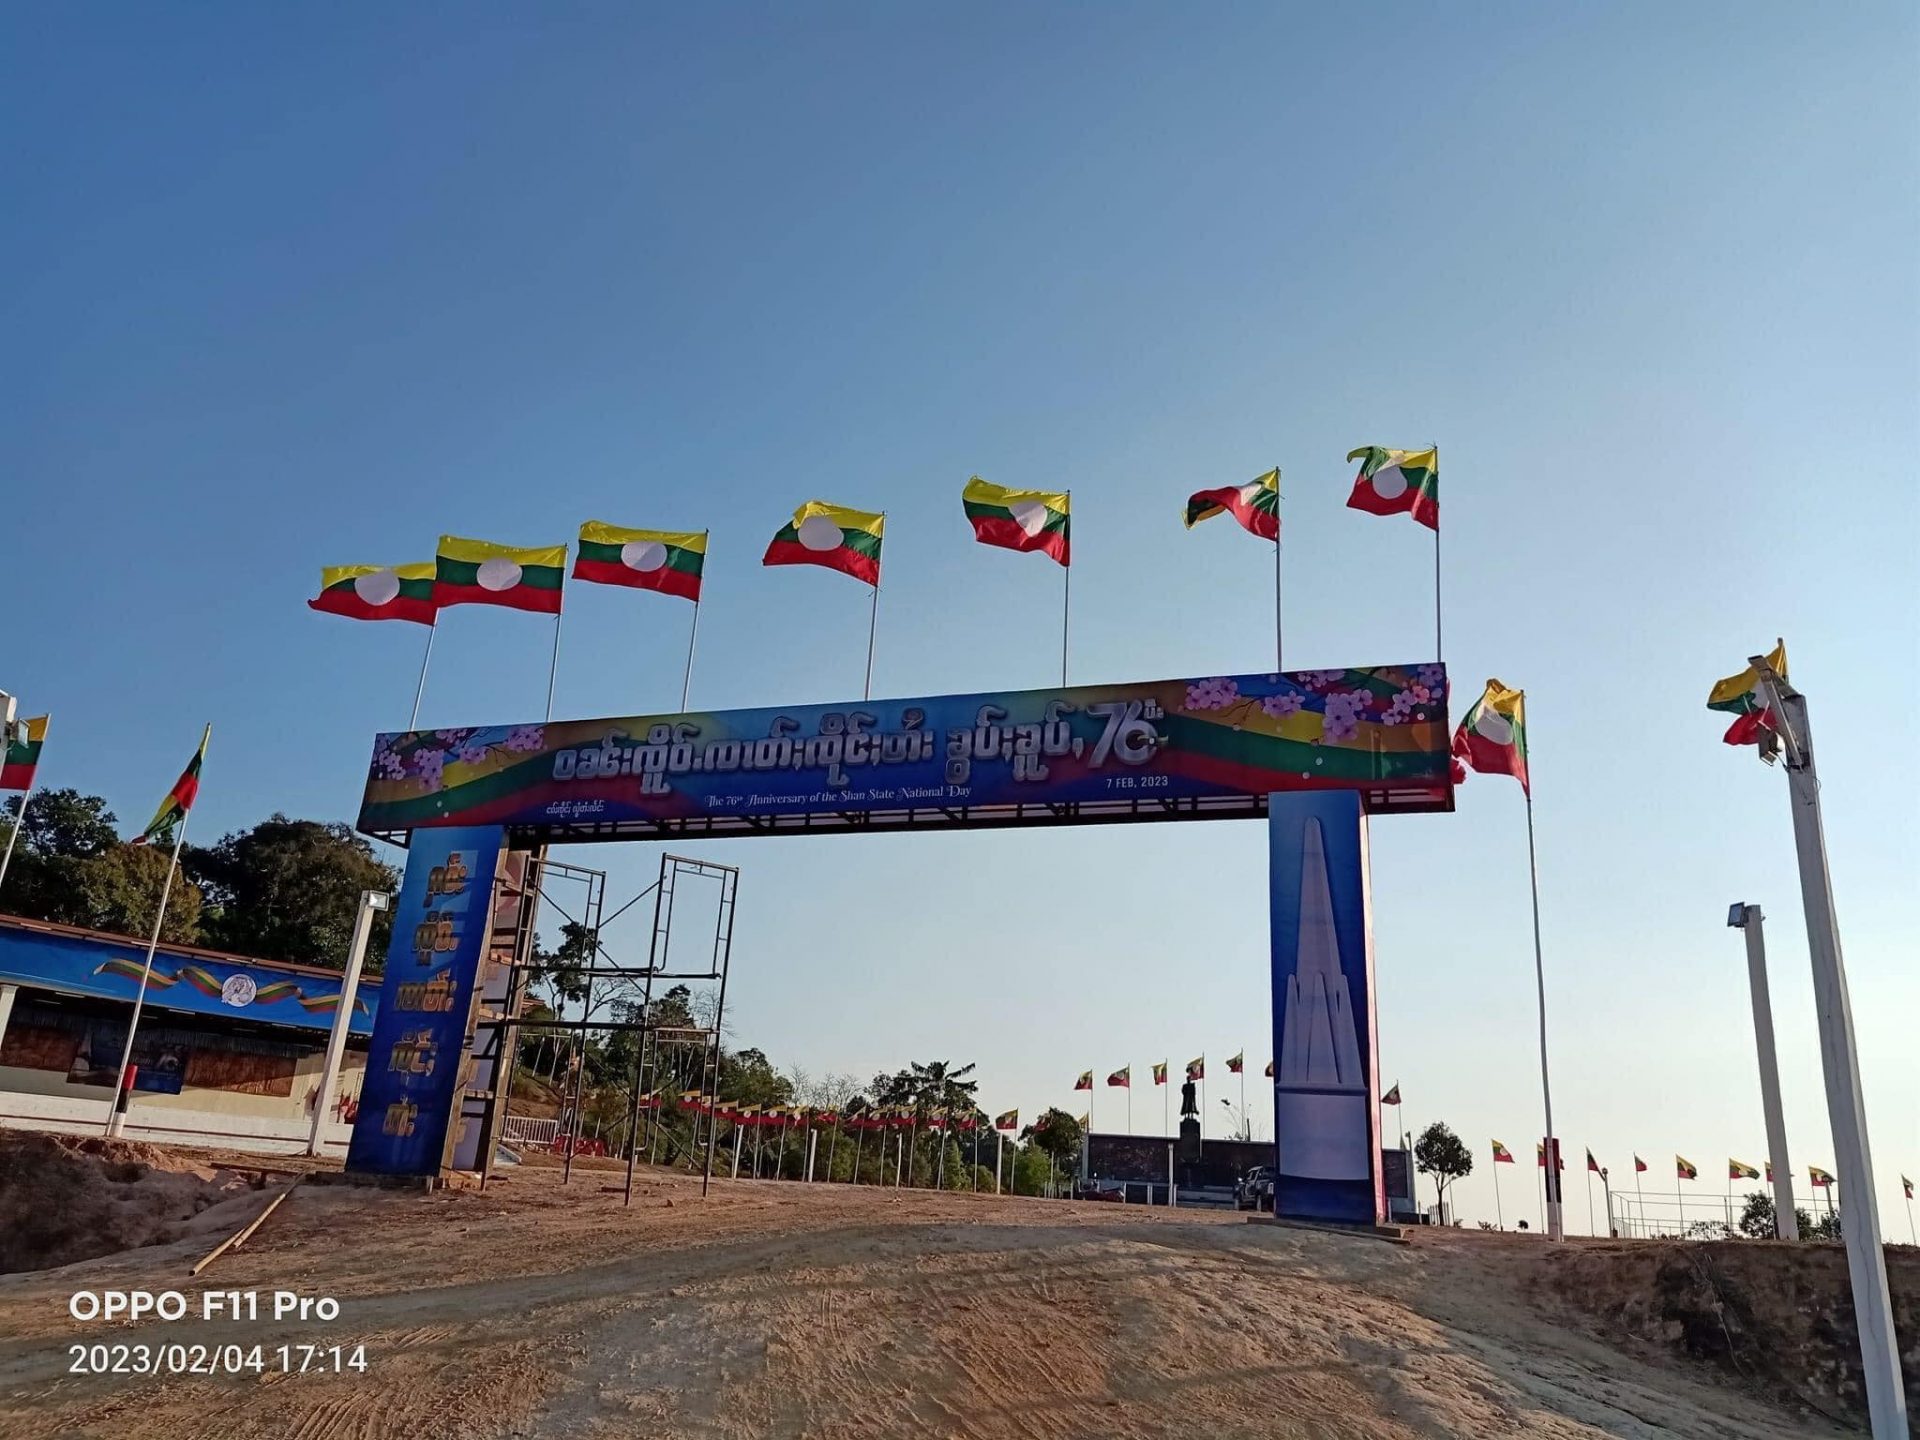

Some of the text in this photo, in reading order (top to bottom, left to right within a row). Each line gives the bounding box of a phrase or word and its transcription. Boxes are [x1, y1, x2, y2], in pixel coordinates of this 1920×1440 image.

[1106, 778, 1113, 789] 7
[1140, 775, 1169, 788] 2023
[705, 794, 724, 807] The
[748, 793, 806, 807] Anniversary
[809, 791, 820, 803] of
[821, 791, 837, 803] the
[839, 789, 865, 802] Shan
[867, 788, 895, 801] State
[896, 785, 943, 801] National
[946, 784, 971, 798] Day
